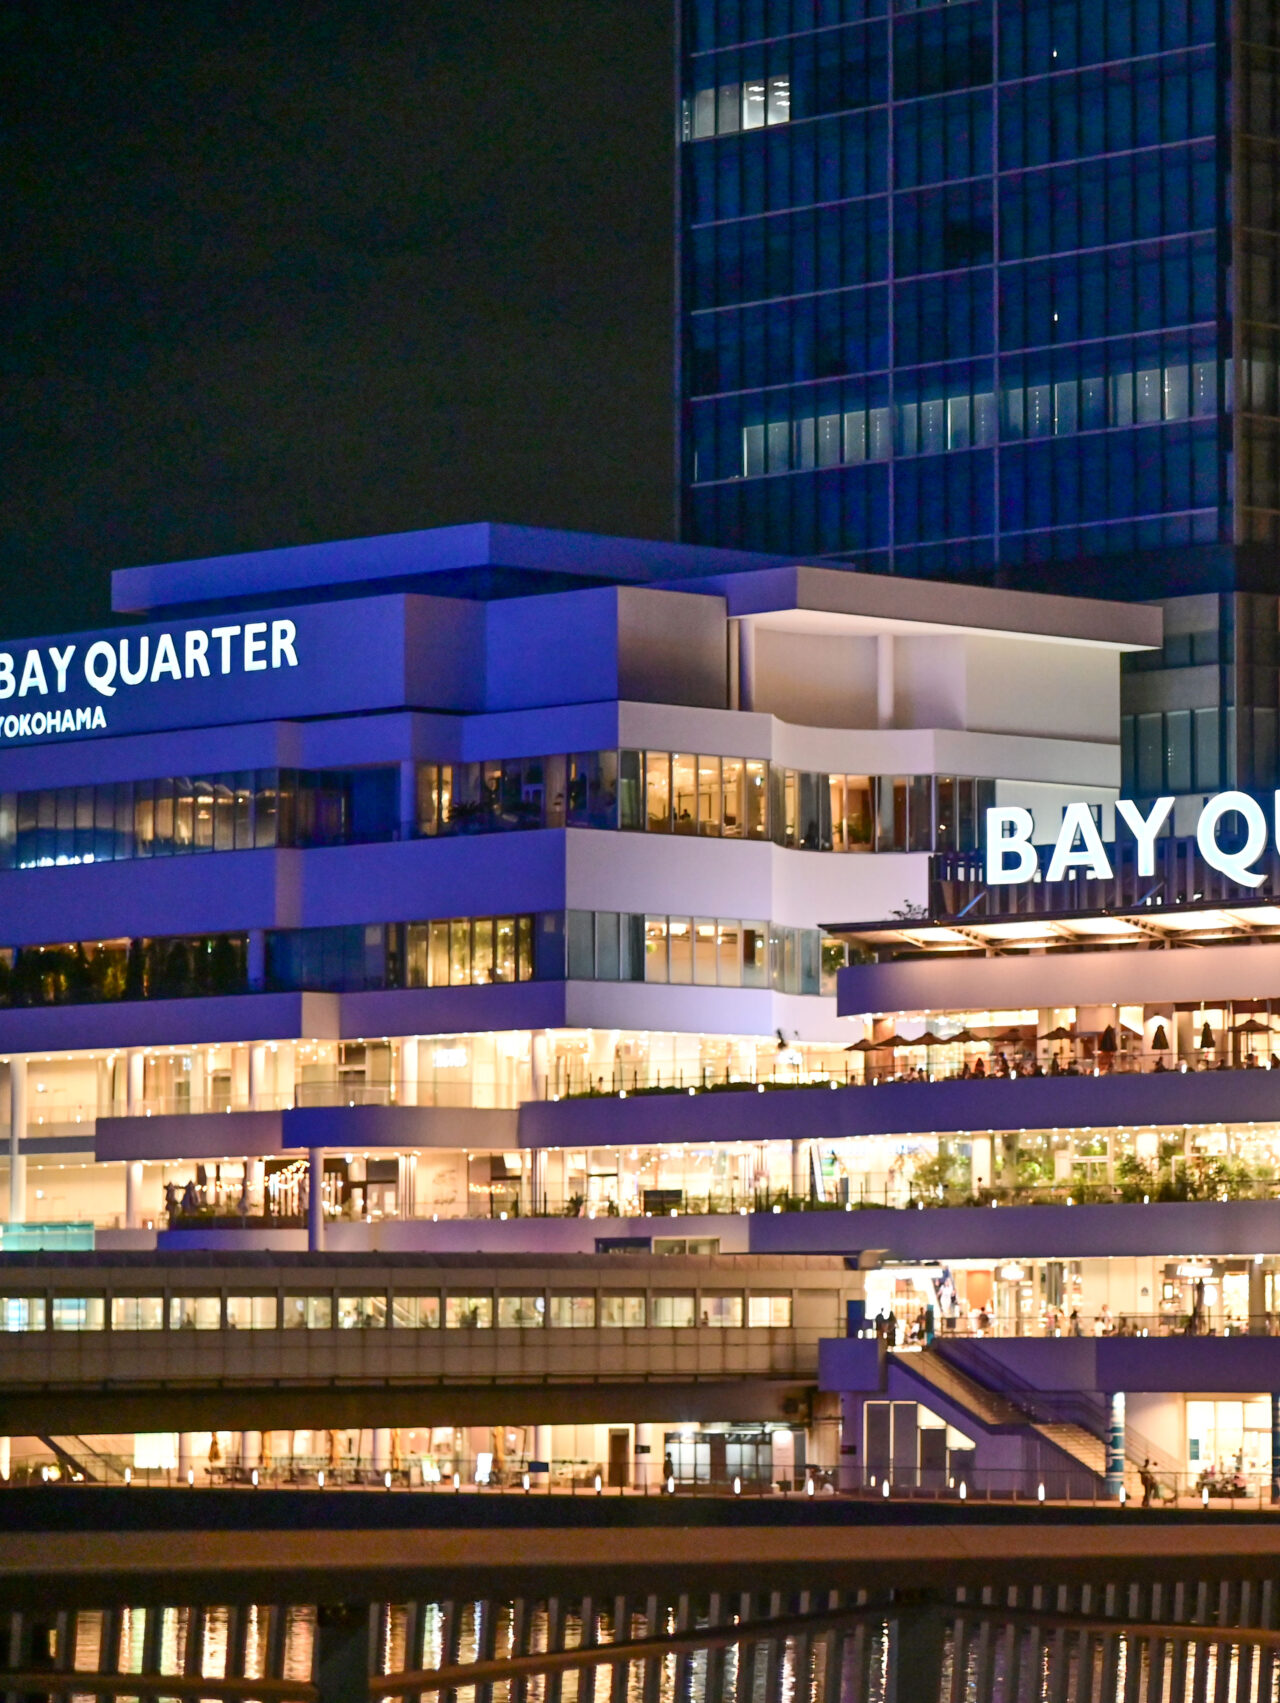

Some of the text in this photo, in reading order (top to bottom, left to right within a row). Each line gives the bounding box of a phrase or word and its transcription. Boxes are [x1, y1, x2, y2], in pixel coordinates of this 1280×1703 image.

[0, 619, 298, 700] BAY QUARTER
[985, 796, 1175, 886] BAY
